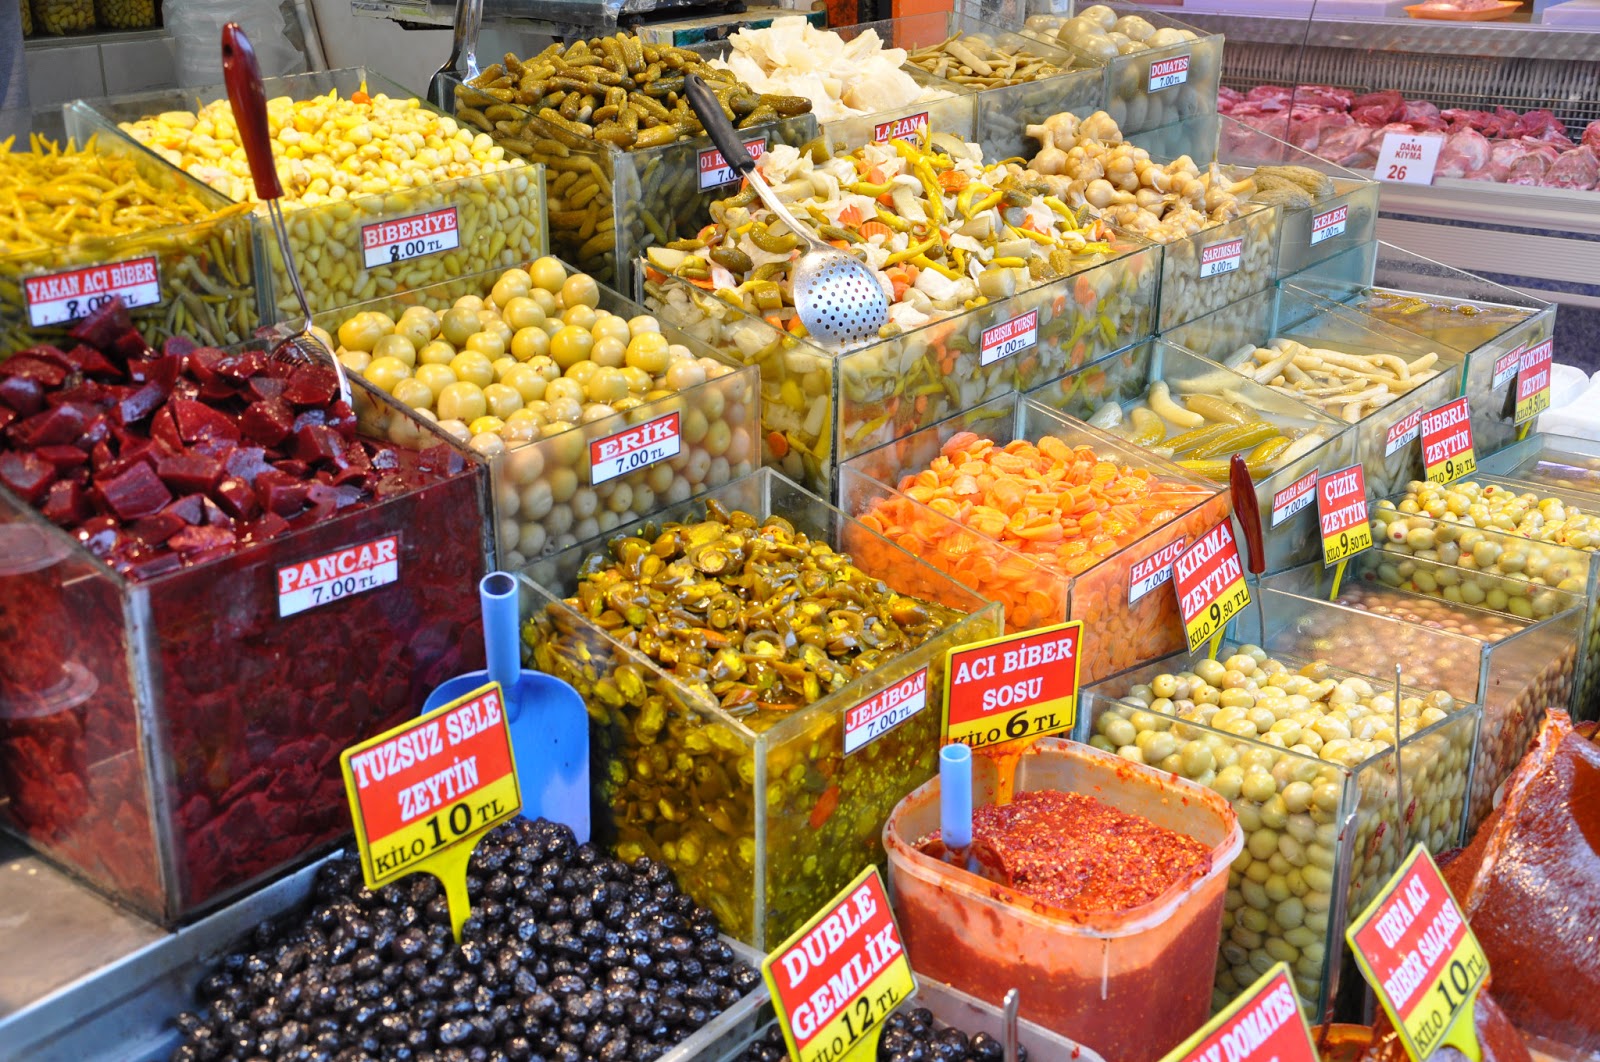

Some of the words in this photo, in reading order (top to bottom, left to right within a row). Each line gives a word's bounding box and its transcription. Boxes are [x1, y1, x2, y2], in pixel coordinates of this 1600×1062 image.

[1152, 58, 1188, 76] DOMATES
[1160, 75, 1174, 86] 7.00
[1395, 151, 1422, 160] KIYMA
[1400, 143, 1422, 152] DANA
[718, 168, 739, 183] 7.0
[1387, 164, 1407, 180] 26
[364, 213, 456, 247] BİBERİYE
[1314, 207, 1346, 230] KELEK
[1320, 226, 1333, 239] 7.00
[427, 240, 442, 251] TL
[1203, 242, 1241, 262] SARIMSAK
[27, 274, 80, 303] YAKAN
[83, 270, 110, 293] ACI
[111, 262, 155, 287] BİBER
[1211, 261, 1226, 273] 8.00
[984, 323, 1012, 346] KARIŞIK
[1014, 313, 1035, 333] TURŞU
[996, 339, 1017, 357] 7.00
[1018, 338, 1026, 348] TL
[1520, 342, 1551, 372] KOKTEYL
[1522, 368, 1547, 397] ZEYTİN
[1387, 410, 1421, 442] ACUR
[1422, 399, 1469, 437] BİBERLİ
[598, 419, 675, 461] ERİK
[1394, 433, 1408, 450] 7.00
[1426, 430, 1469, 464] ZEYTİN
[616, 449, 648, 472] 7.00
[651, 448, 664, 459] TL
[1465, 458, 1474, 471] TL
[1325, 471, 1358, 506] ÇİZİK
[1284, 499, 1300, 517] 7.00
[1322, 500, 1366, 534] ZEYTİN
[1175, 524, 1232, 584] KIRMA
[1326, 546, 1340, 561] KİLO
[1359, 533, 1369, 546] TL
[280, 539, 397, 592] PANCAR
[1144, 569, 1165, 591] 7.00
[312, 577, 355, 603] 7.00
[360, 575, 377, 588] TL
[1181, 553, 1240, 620] ZEYTİN
[1189, 622, 1210, 648] KİLO
[1234, 589, 1248, 606] TL
[954, 656, 996, 685] ACI
[1002, 638, 1073, 674] BİBER
[846, 672, 926, 731] JELİBON
[982, 677, 1043, 711] SOSU
[868, 709, 897, 737] 7.00
[899, 706, 911, 718] TL
[1006, 710, 1029, 738] 6
[1034, 713, 1060, 731] TL
[351, 722, 443, 789] TUZSUZ
[446, 694, 500, 746] SELE
[398, 756, 479, 822] ZEYTİN
[375, 838, 425, 875] KİLO
[427, 802, 472, 850] 10
[477, 800, 504, 823] TL
[1375, 898, 1414, 949] URFA
[1404, 874, 1431, 916] ACI
[782, 885, 877, 989] DUBLE
[1383, 950, 1428, 1010] BİBER
[1417, 897, 1462, 967] SALÇASI
[791, 922, 901, 1040] GEMLİK
[841, 996, 874, 1046] 12
[876, 987, 899, 1013] TL
[1413, 1009, 1444, 1054] KİLO
[1437, 959, 1469, 1016] 10
[1468, 954, 1482, 978] TL
[1220, 982, 1297, 1062] DOMATES
